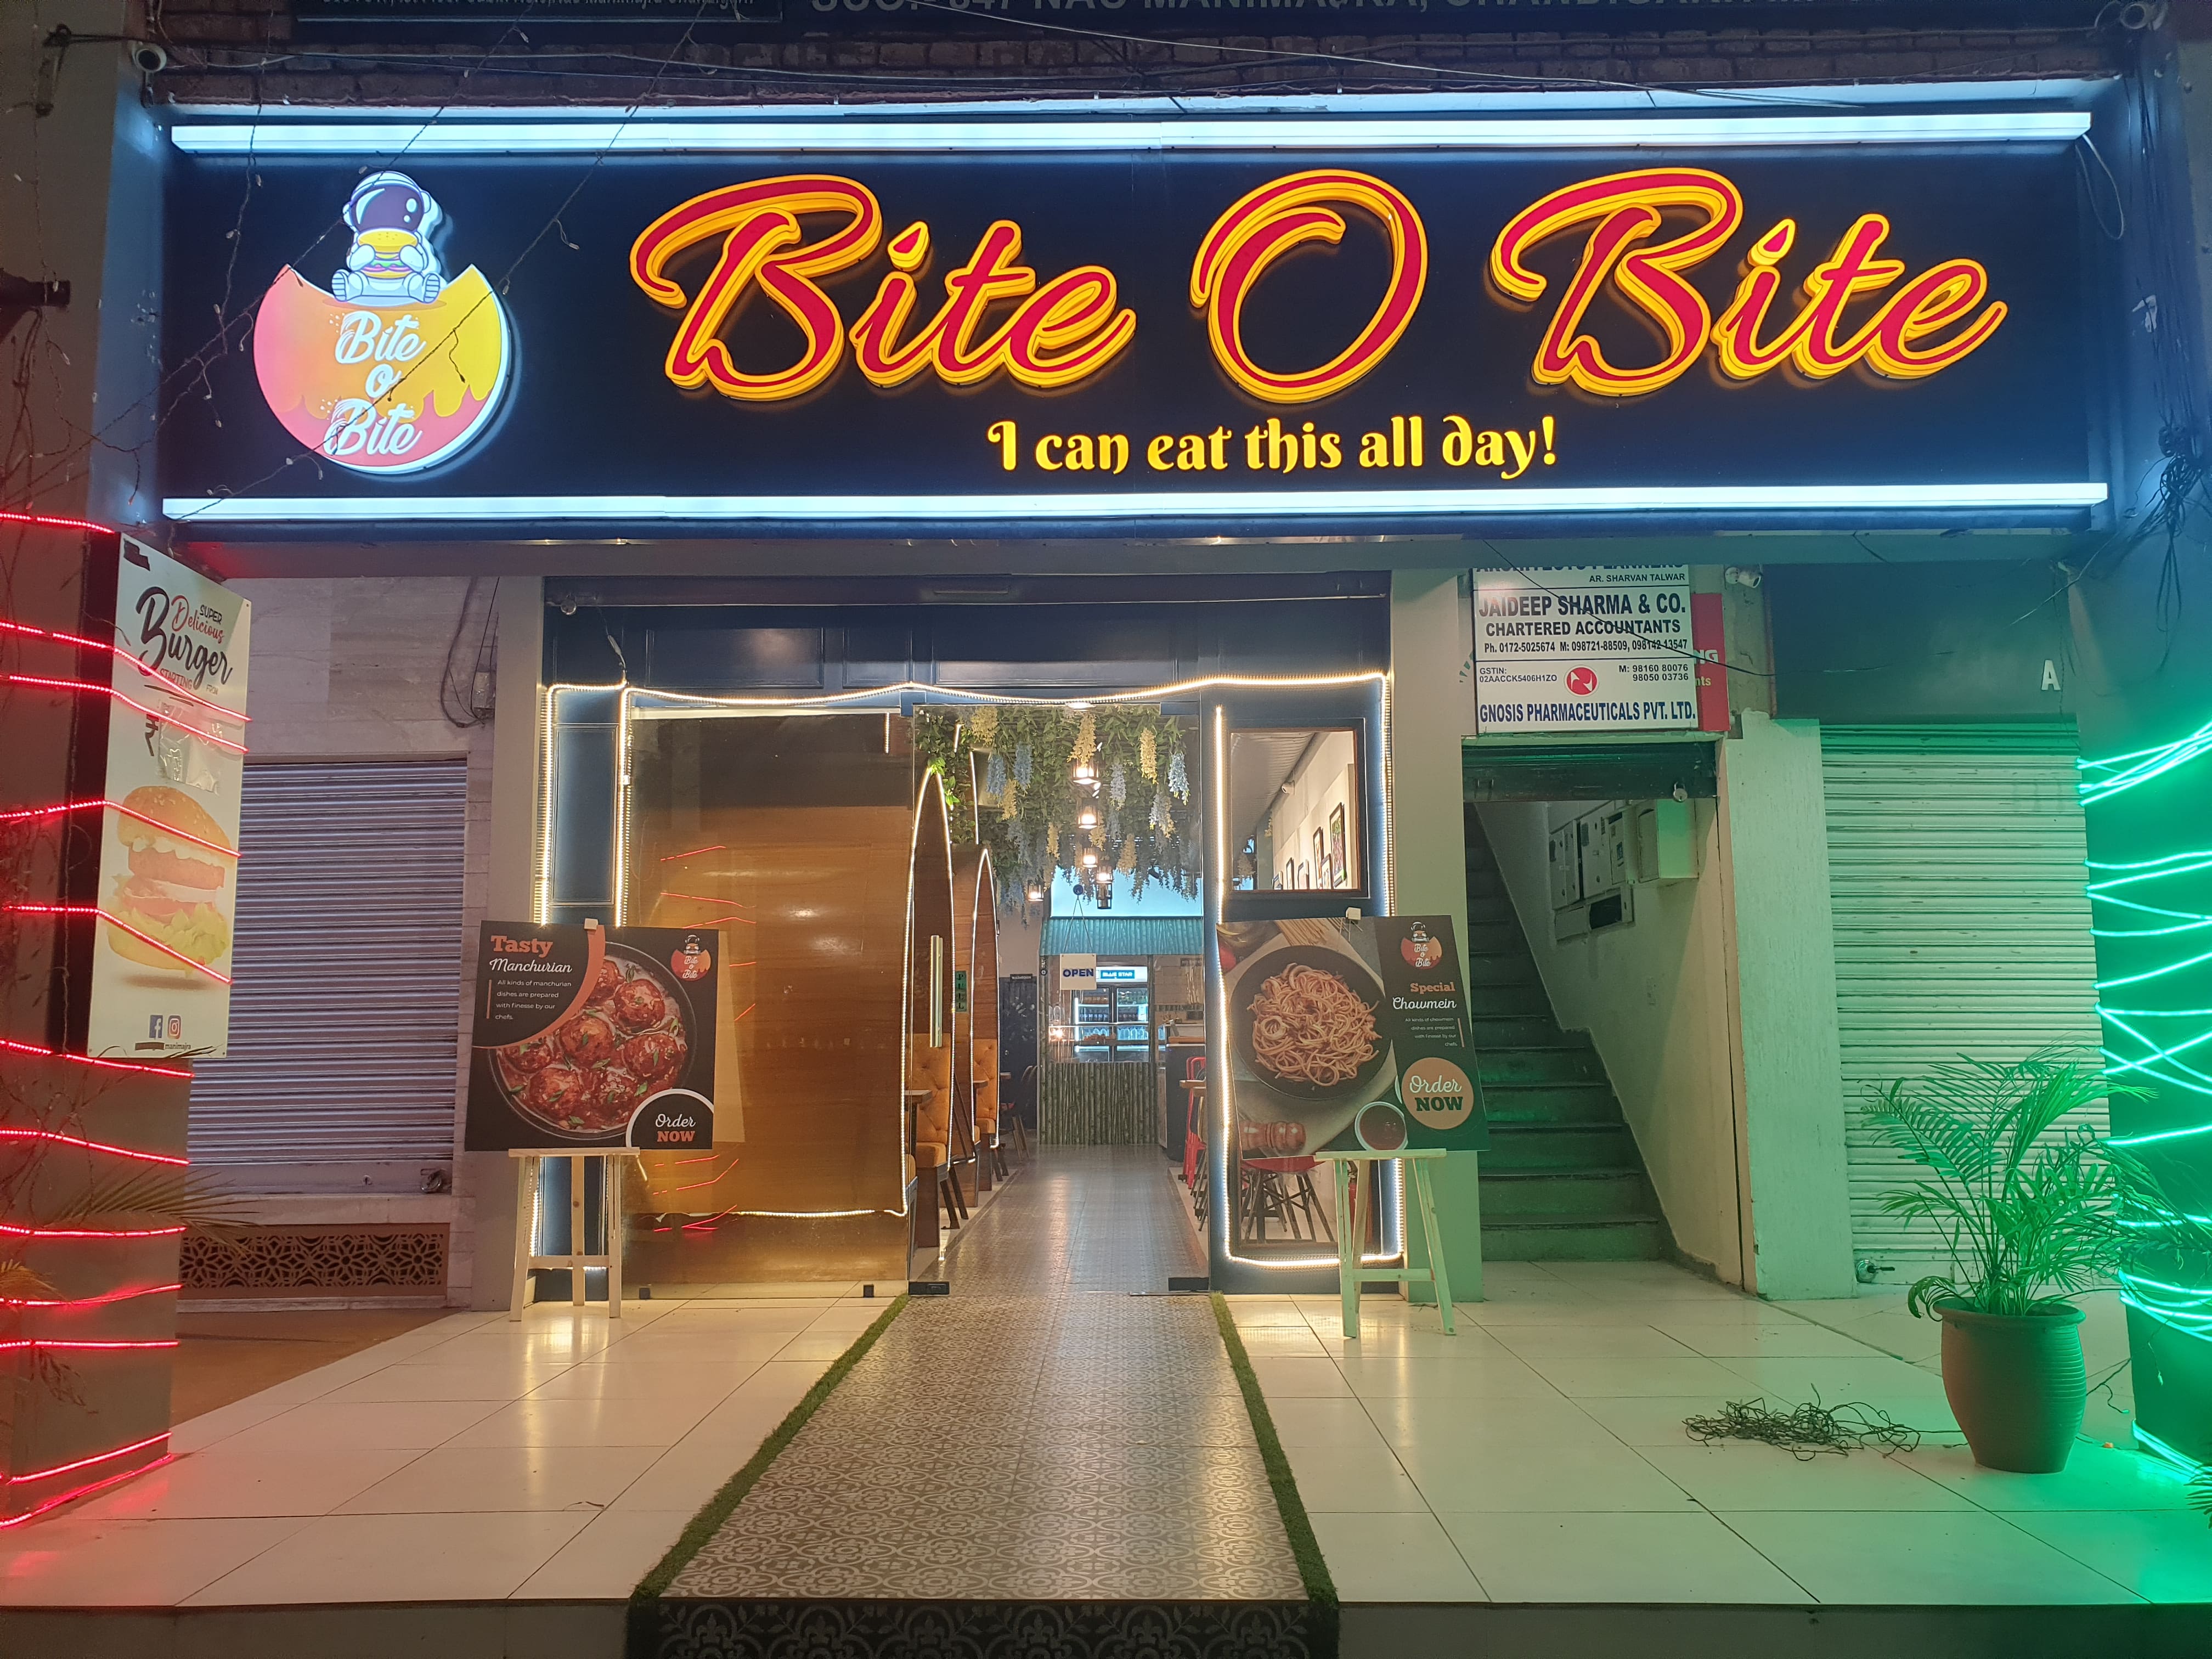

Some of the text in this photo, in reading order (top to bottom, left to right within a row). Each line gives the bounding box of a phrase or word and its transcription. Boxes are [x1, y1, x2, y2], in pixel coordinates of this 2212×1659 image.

[629, 167, 2008, 403] Bite O Bite
[334, 311, 426, 364] Bite
[323, 398, 422, 456] Bite
[988, 416, 1556, 480] I can eat this all day!
[1606, 574, 1647, 582] SHARVAN
[1650, 573, 1685, 582] TALWAR
[1479, 592, 1686, 617] JAIDEEP SHARMA & CO.
[171, 595, 225, 644] Delicious
[199, 604, 222, 625] SUPER
[1486, 619, 1681, 636] CHARTERED ACCOUNTANTS
[136, 586, 233, 690] Burger
[1485, 643, 1497, 653] Ph.
[1499, 641, 1555, 652] 0172-5025674
[1560, 641, 1570, 652] M:
[1571, 640, 1630, 652] 098721-88509,
[1632, 664, 1659, 673] 98160
[1661, 664, 1688, 672] 80076
[1633, 673, 1689, 682] 98050 03736
[2041, 659, 2061, 691] A
[1480, 701, 1696, 723] GNOSIS PHARMACEUTICALS PVT. LTD.
[490, 935, 554, 958] Tasty
[489, 958, 573, 973] Manchurian
[1063, 968, 1094, 977] OPEN
[1410, 981, 1455, 994] Special
[1392, 996, 1457, 1010] Chowmein
[1409, 1075, 1462, 1094] Order
[1414, 1096, 1463, 1111] NOW
[655, 1113, 696, 1128] Order
[657, 1131, 695, 1142] NOW
